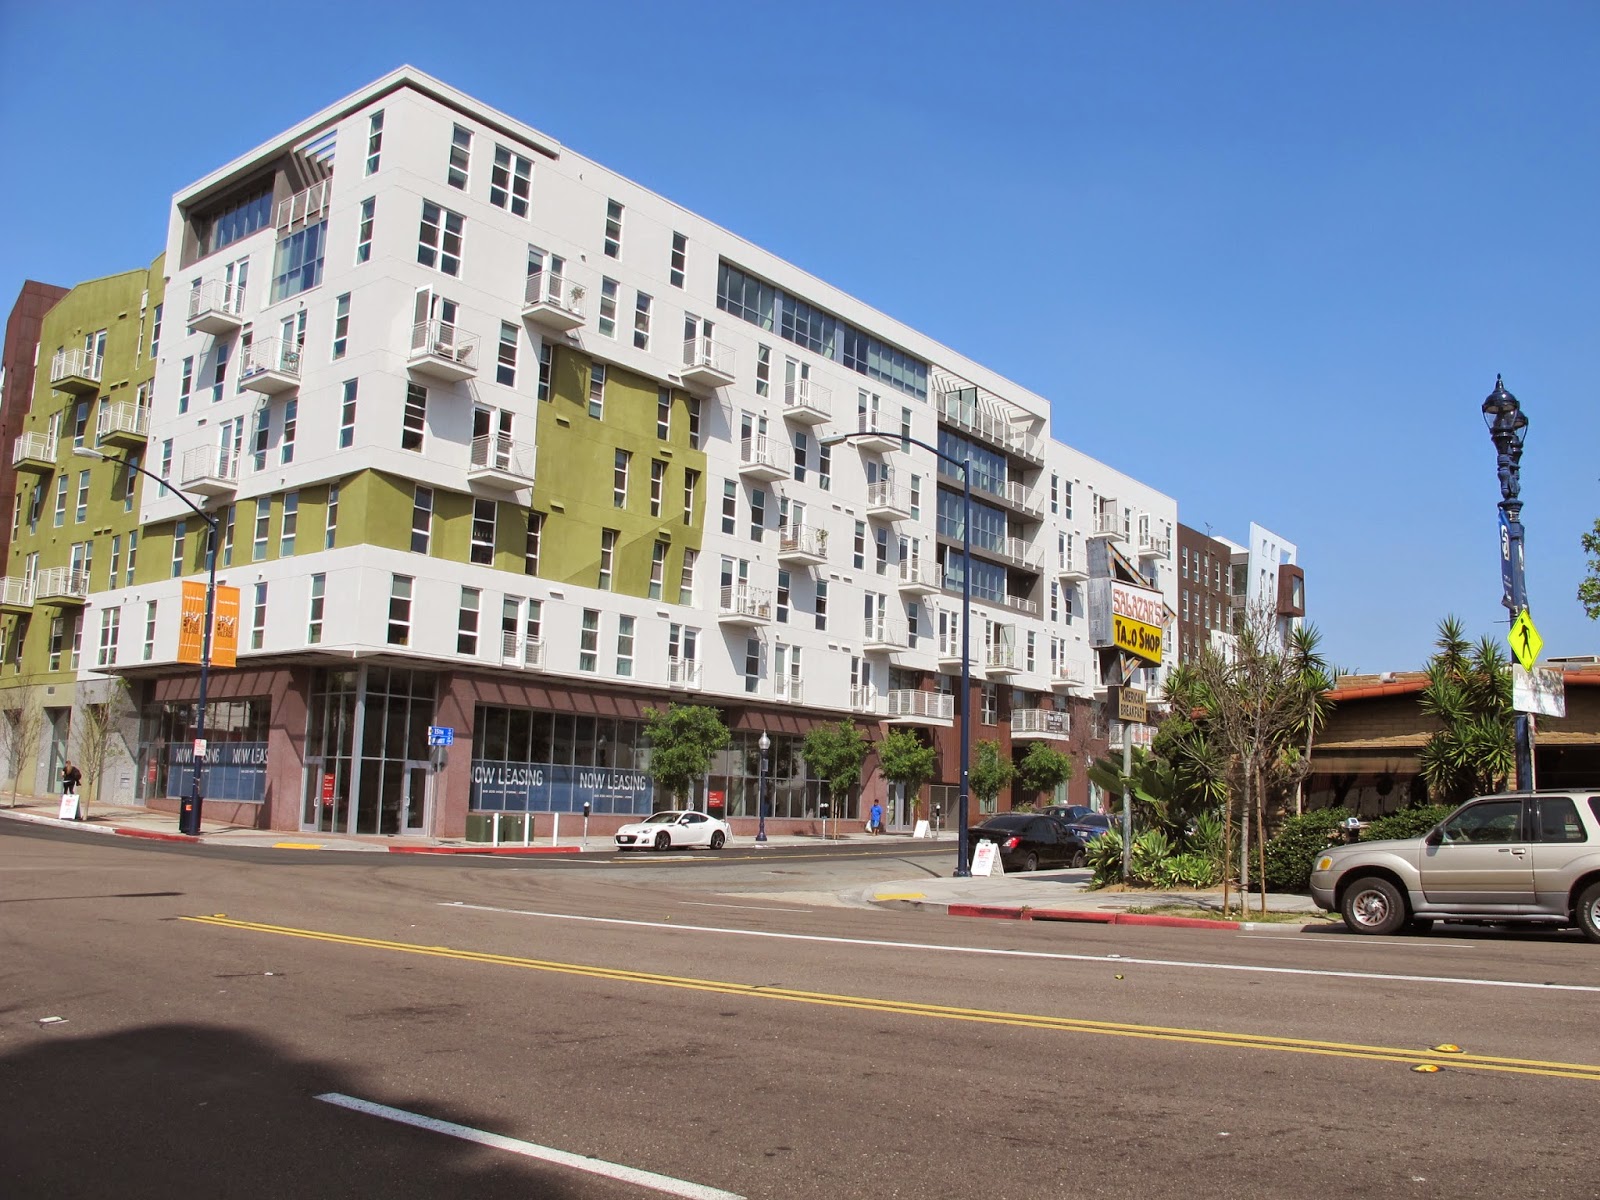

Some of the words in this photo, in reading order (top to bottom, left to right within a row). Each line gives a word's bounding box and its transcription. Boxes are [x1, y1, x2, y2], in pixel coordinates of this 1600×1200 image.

[1113, 588, 1162, 626] SALAZAR'S
[1139, 626, 1160, 653] SHOP
[1121, 703, 1145, 719] BREAKFAST
[498, 768, 543, 787] LEASING
[579, 772, 604, 789] NOW
[607, 774, 646, 791] LEASING
